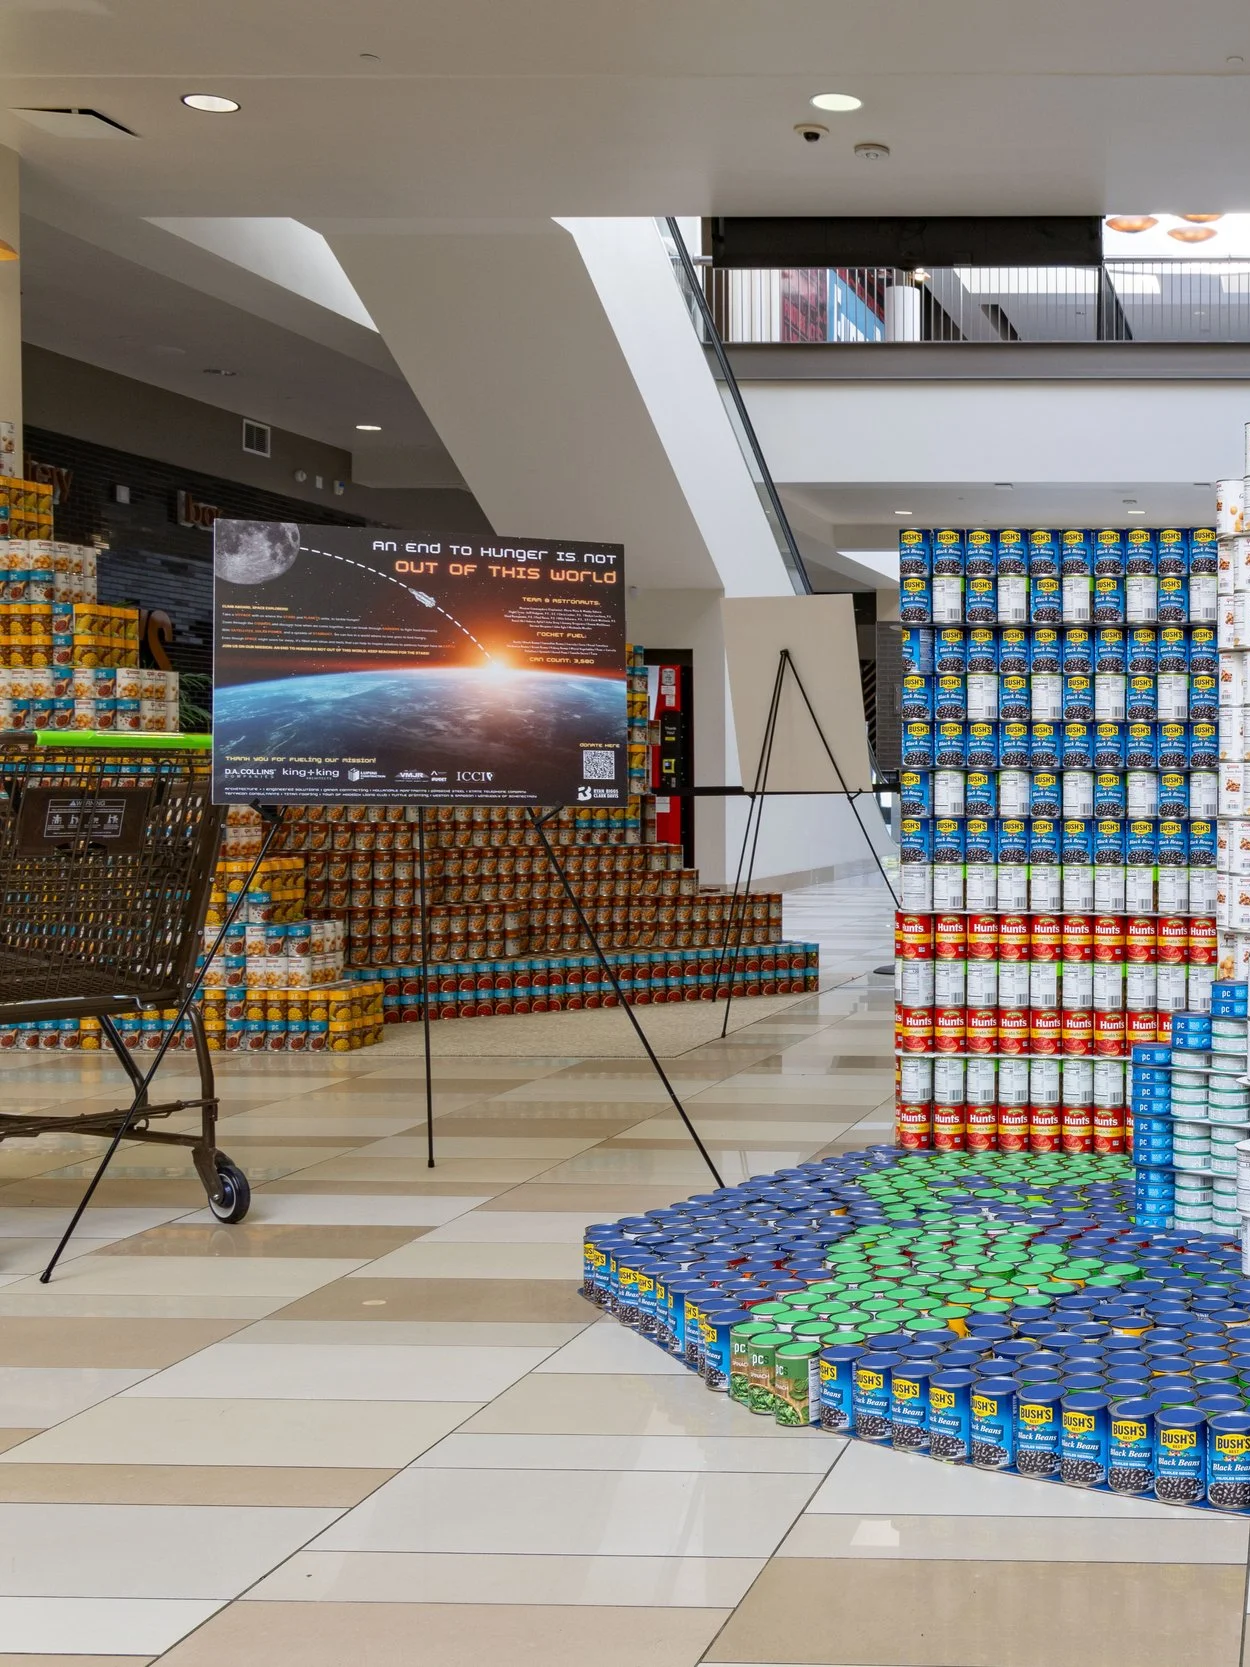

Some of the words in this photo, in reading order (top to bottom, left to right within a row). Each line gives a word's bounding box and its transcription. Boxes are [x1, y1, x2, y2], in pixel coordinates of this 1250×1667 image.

[938, 534, 959, 542] BUSH'S
[970, 534, 990, 542] BUSH'S
[450, 546, 472, 556] TO
[556, 552, 576, 562] IS
[396, 560, 438, 574] OUT
[449, 564, 477, 576] OF
[488, 566, 540, 580] THIS
[1020, 1407, 1051, 1420] BUSH'S
[1035, 1433, 1057, 1441] Beans
[1162, 1433, 1195, 1445] BUSH'S
[1217, 1438, 1250, 1449] BUSH'S
[1158, 1458, 1176, 1466] Black
[1178, 1459, 1200, 1467] Beans
[1213, 1463, 1232, 1471] Black
